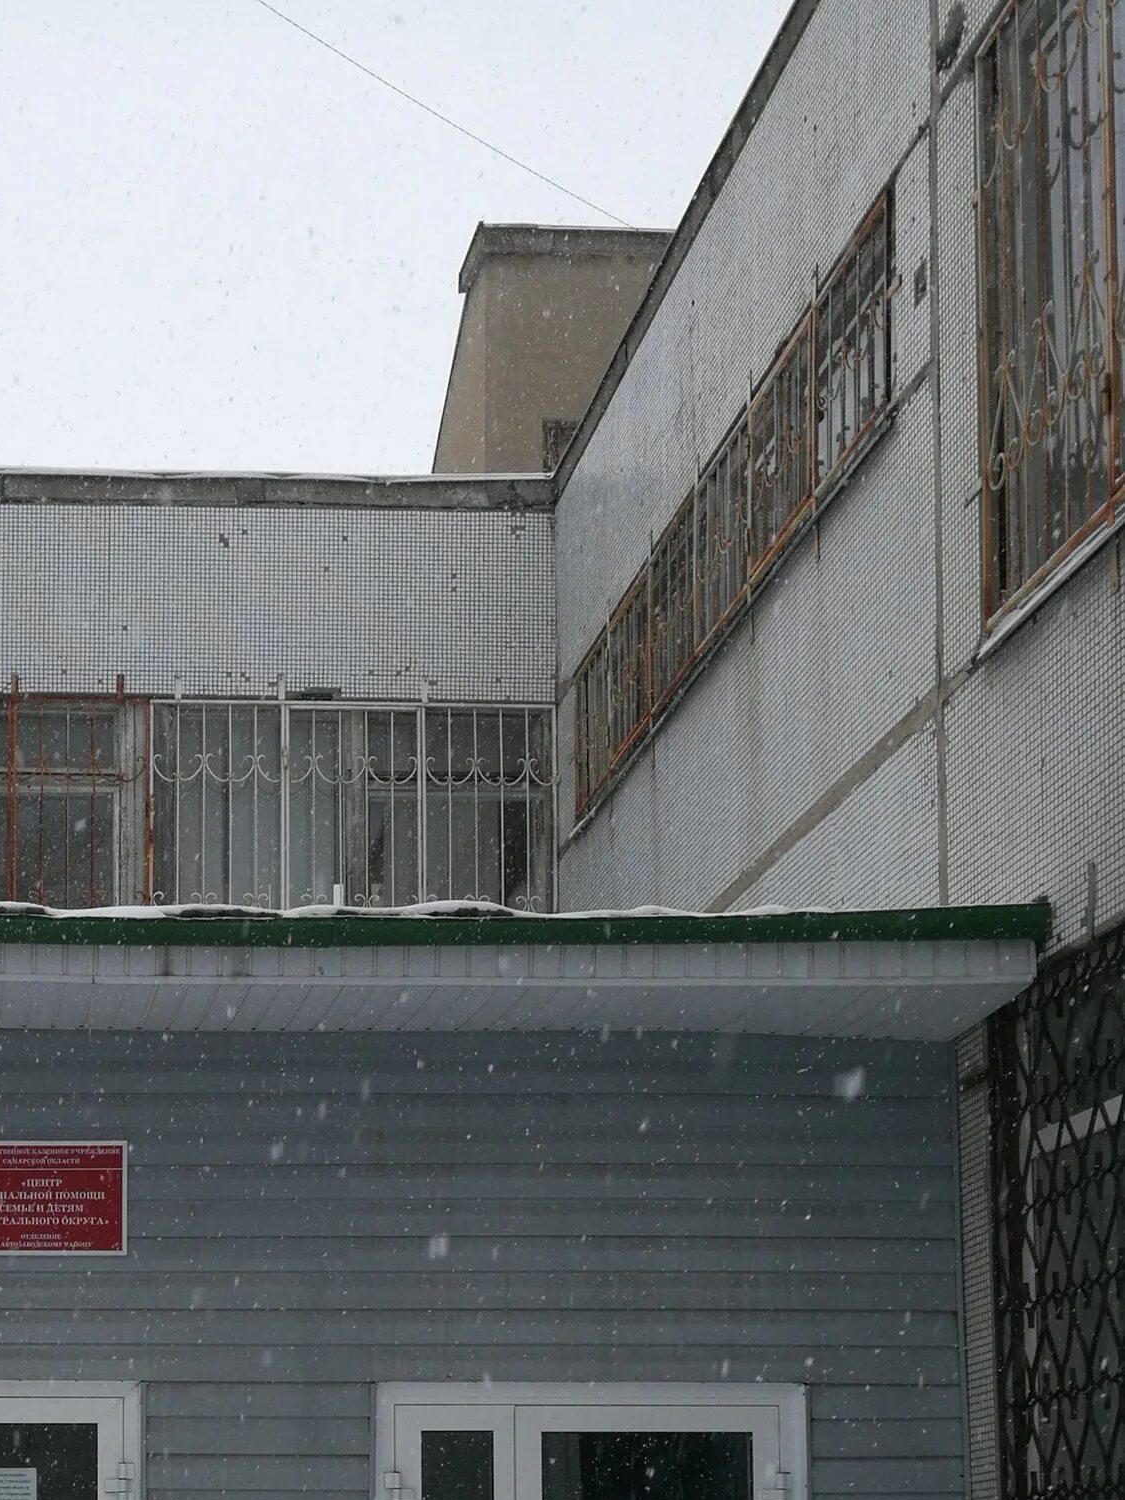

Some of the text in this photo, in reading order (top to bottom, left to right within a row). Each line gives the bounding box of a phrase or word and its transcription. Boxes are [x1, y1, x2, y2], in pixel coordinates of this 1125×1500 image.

[71, 1148, 121, 1156] УЧРЕЖДЕНИЕ
[2, 1157, 80, 1165] САМАРСКОЙ ОБЛАСТИ
[55, 1191, 106, 1201] ПОМОЩИ
[36, 1204, 44, 1213] И
[46, 1203, 84, 1214] ДЕТЯМ
[0, 1241, 63, 1249] АВТОЗАВОДСКОМУ
